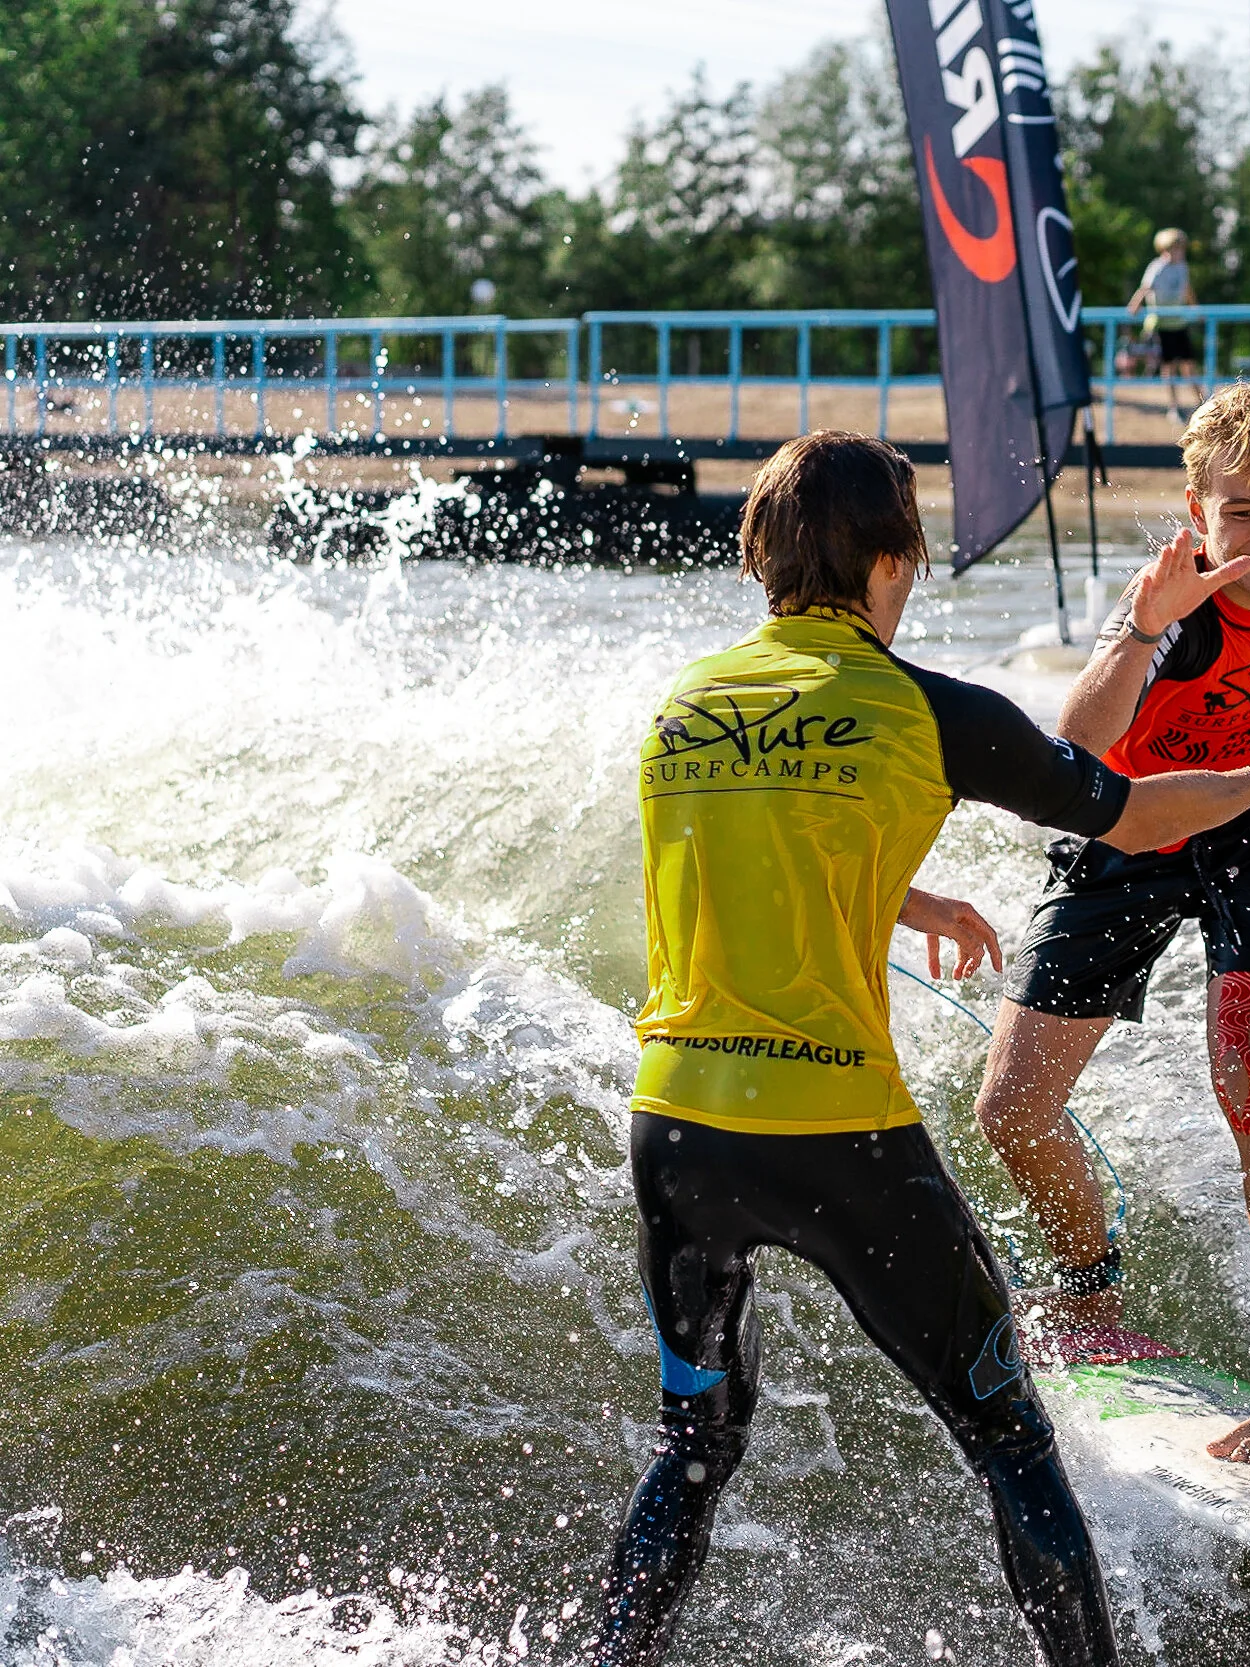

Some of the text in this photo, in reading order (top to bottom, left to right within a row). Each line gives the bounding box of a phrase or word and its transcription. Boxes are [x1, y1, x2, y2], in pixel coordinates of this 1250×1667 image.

[930, 0, 1000, 158] RI
[674, 684, 876, 765] Pure
[643, 758, 858, 785] SURFCAMPS
